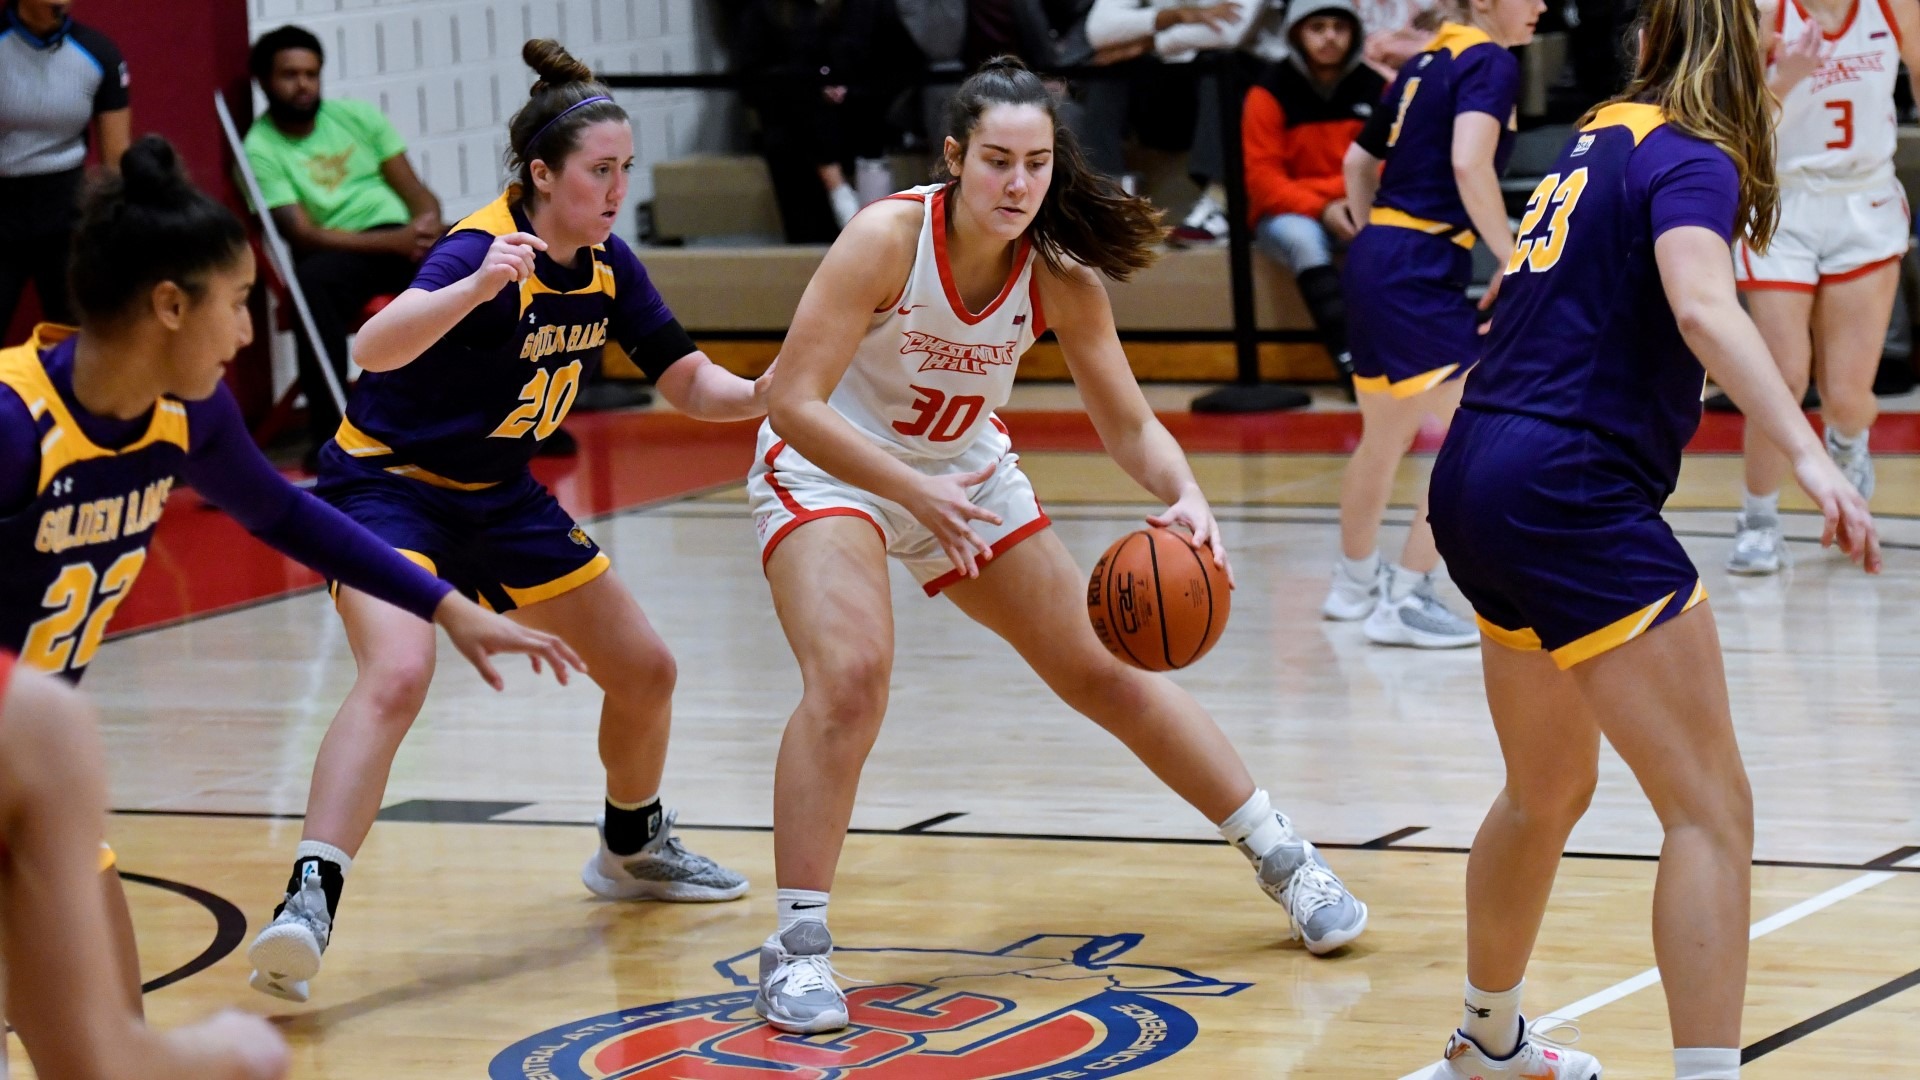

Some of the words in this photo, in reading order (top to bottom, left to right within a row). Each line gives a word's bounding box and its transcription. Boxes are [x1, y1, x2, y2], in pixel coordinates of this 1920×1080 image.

[1824, 100, 1853, 150] 3
[1503, 166, 1589, 276] 23
[900, 331, 1017, 365] CHESTNUT
[918, 353, 987, 375] HILL
[486, 359, 583, 442] 20
[891, 384, 985, 442] 30
[35, 496, 124, 554] GOLDEN
[21, 547, 146, 673] 22
[522, 1042, 570, 1080] ENTRAL
[562, 997, 752, 1042] ATLANTIC
[1083, 1003, 1168, 1070] CONFERENCE
